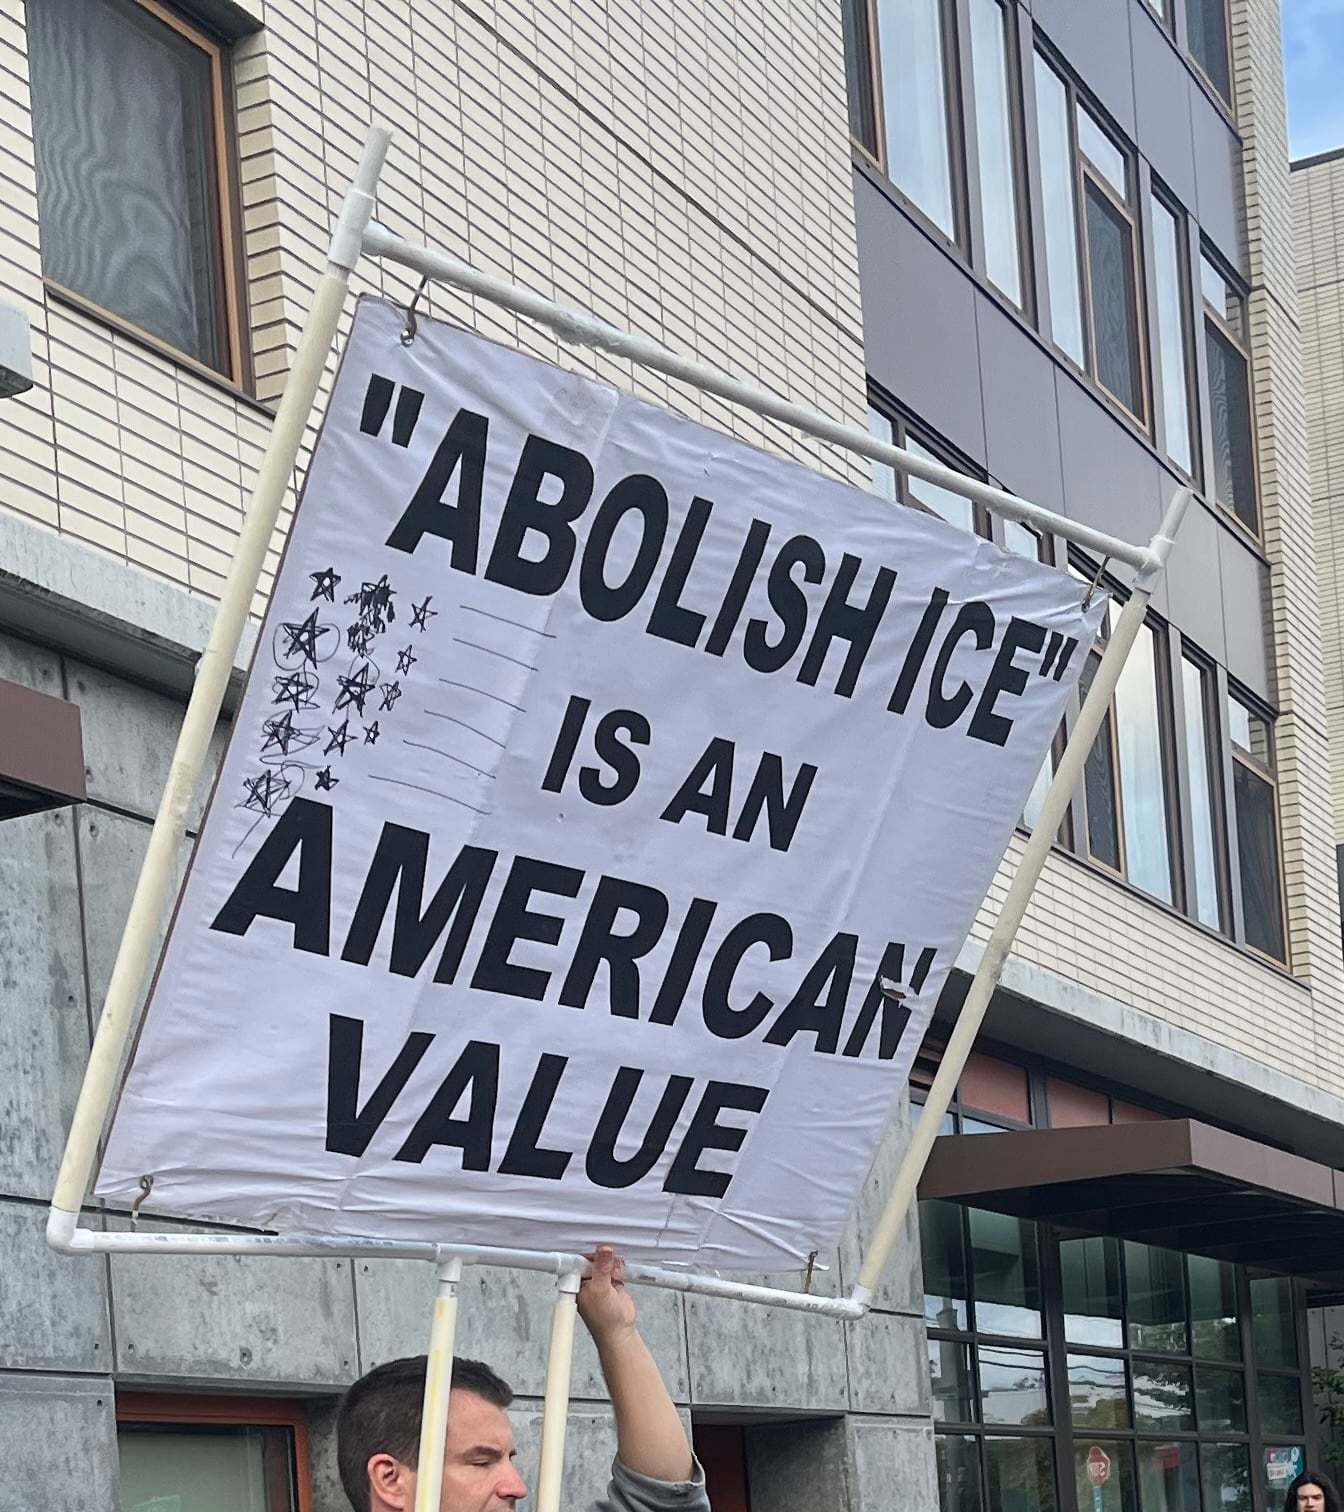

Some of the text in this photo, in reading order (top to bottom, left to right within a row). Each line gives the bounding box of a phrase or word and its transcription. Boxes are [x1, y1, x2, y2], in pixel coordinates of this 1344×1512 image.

[359, 374, 1078, 747] "ABOLISH ICE"
[542, 695, 818, 852] IS AN
[209, 796, 938, 1060] AMERICAN
[325, 1012, 769, 1199] VALUE
